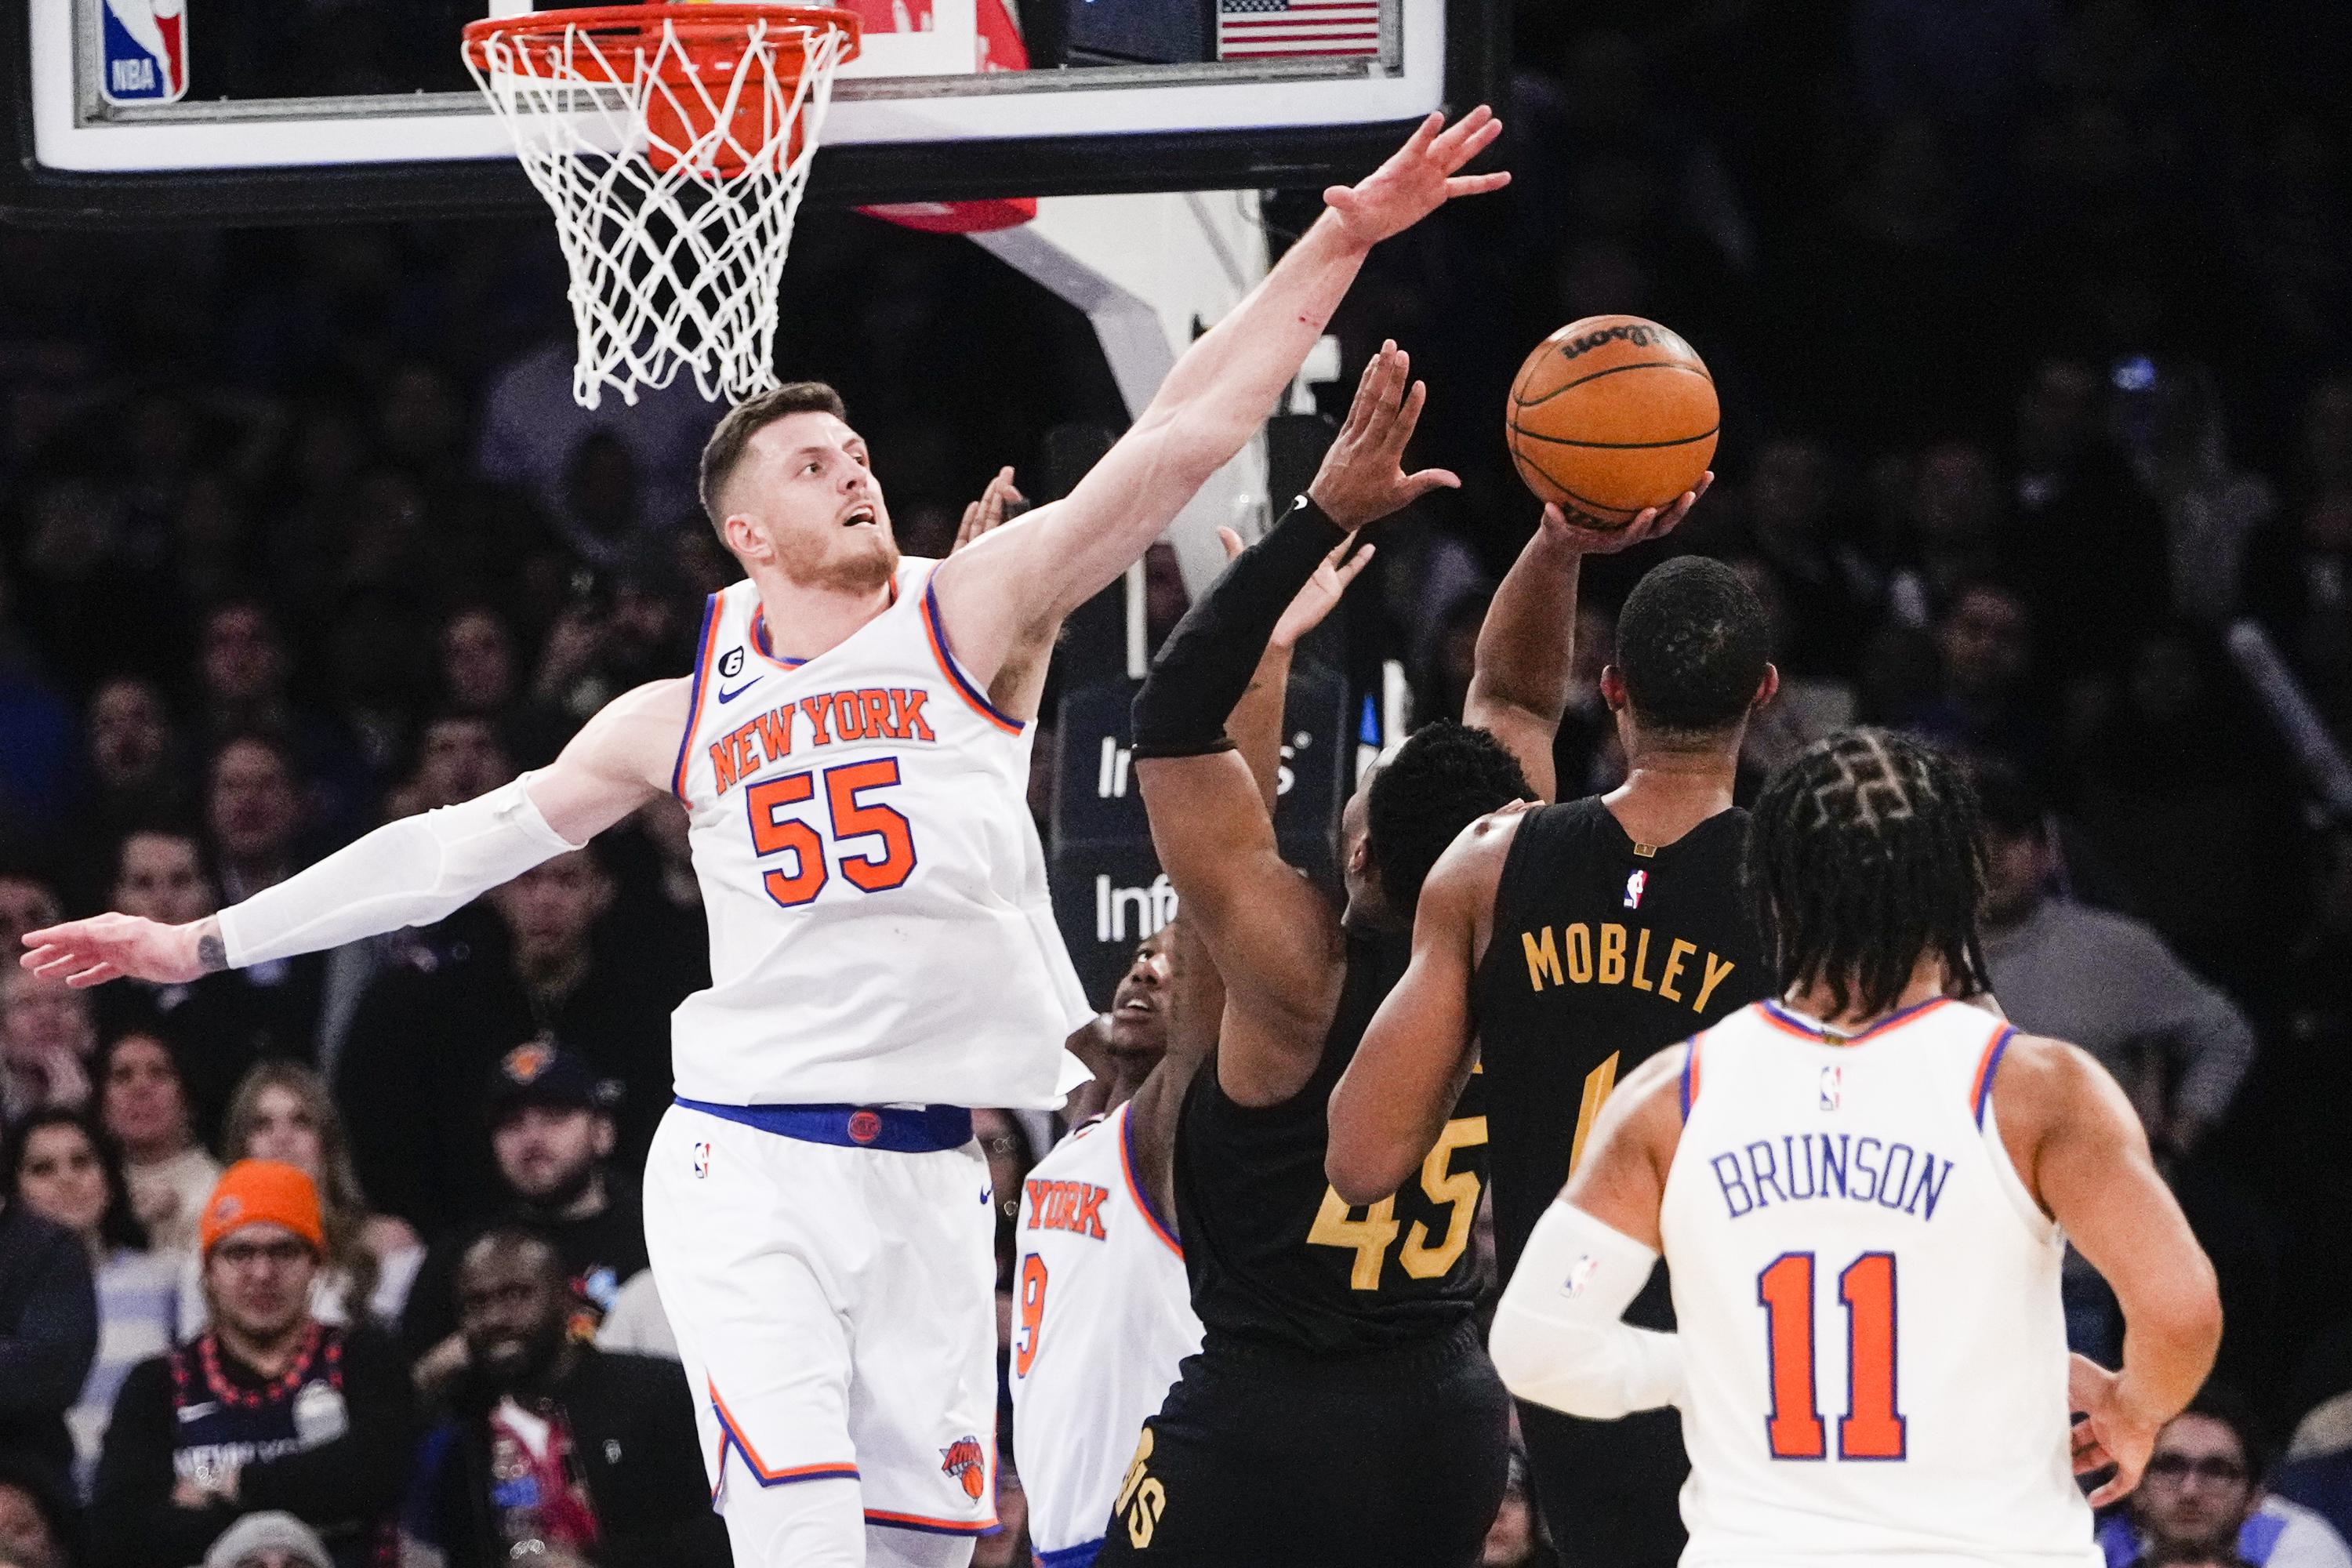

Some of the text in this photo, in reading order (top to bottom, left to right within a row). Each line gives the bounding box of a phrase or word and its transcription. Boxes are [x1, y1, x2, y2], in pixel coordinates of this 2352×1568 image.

[111, 58, 156, 92] NBA
[710, 688, 936, 795] NEW YORK
[746, 757, 917, 908] 55
[1522, 923, 1735, 1014] MOBLEY
[1026, 1179, 1109, 1241] YORK
[1306, 1116, 1488, 1290] 45
[1711, 1134, 1955, 1221] BRUNSON
[1757, 1251, 1907, 1461] 11
